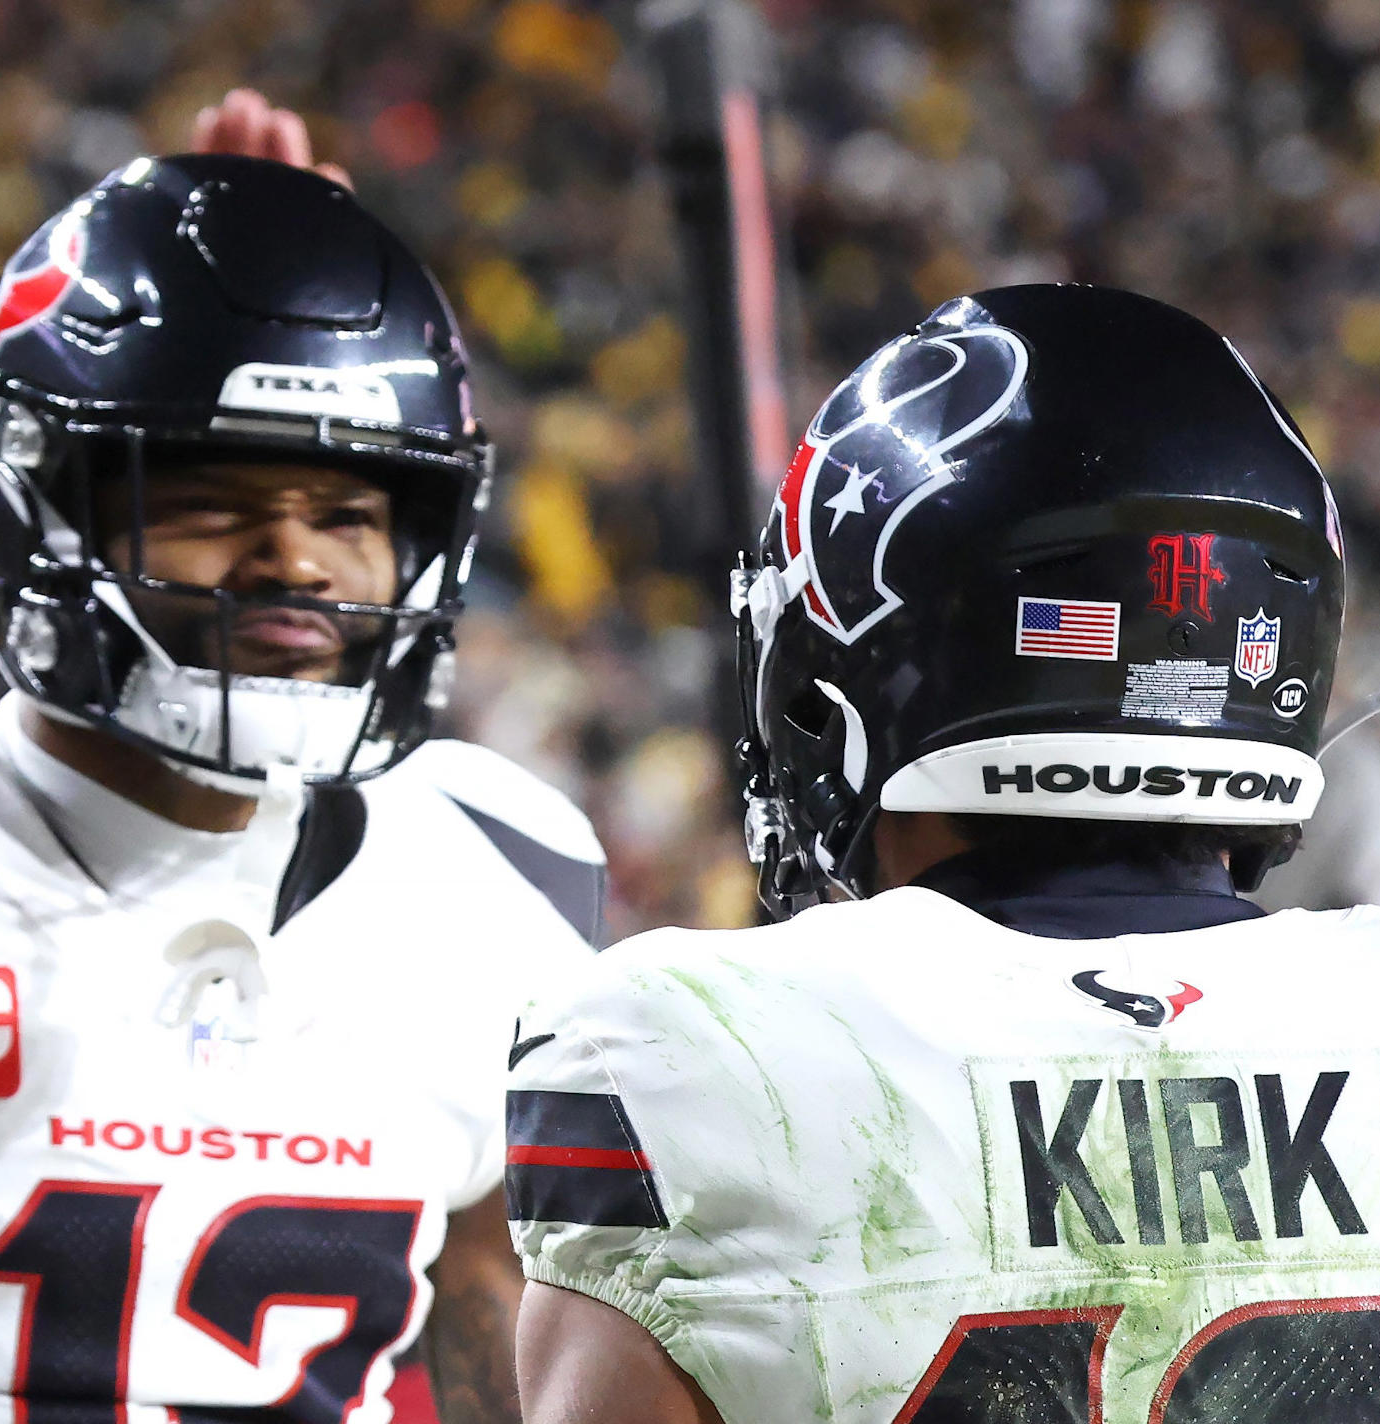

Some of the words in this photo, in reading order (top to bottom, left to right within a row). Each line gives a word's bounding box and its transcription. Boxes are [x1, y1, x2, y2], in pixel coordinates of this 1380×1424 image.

[249, 374, 381, 396] TEXA
[1154, 659, 1208, 667] WARNING
[1241, 644, 1272, 674] NFL
[982, 764, 1302, 804] HOUSTON
[49, 1116, 373, 1168] HOUSTON
[1009, 1070, 1369, 1248] KIRK
